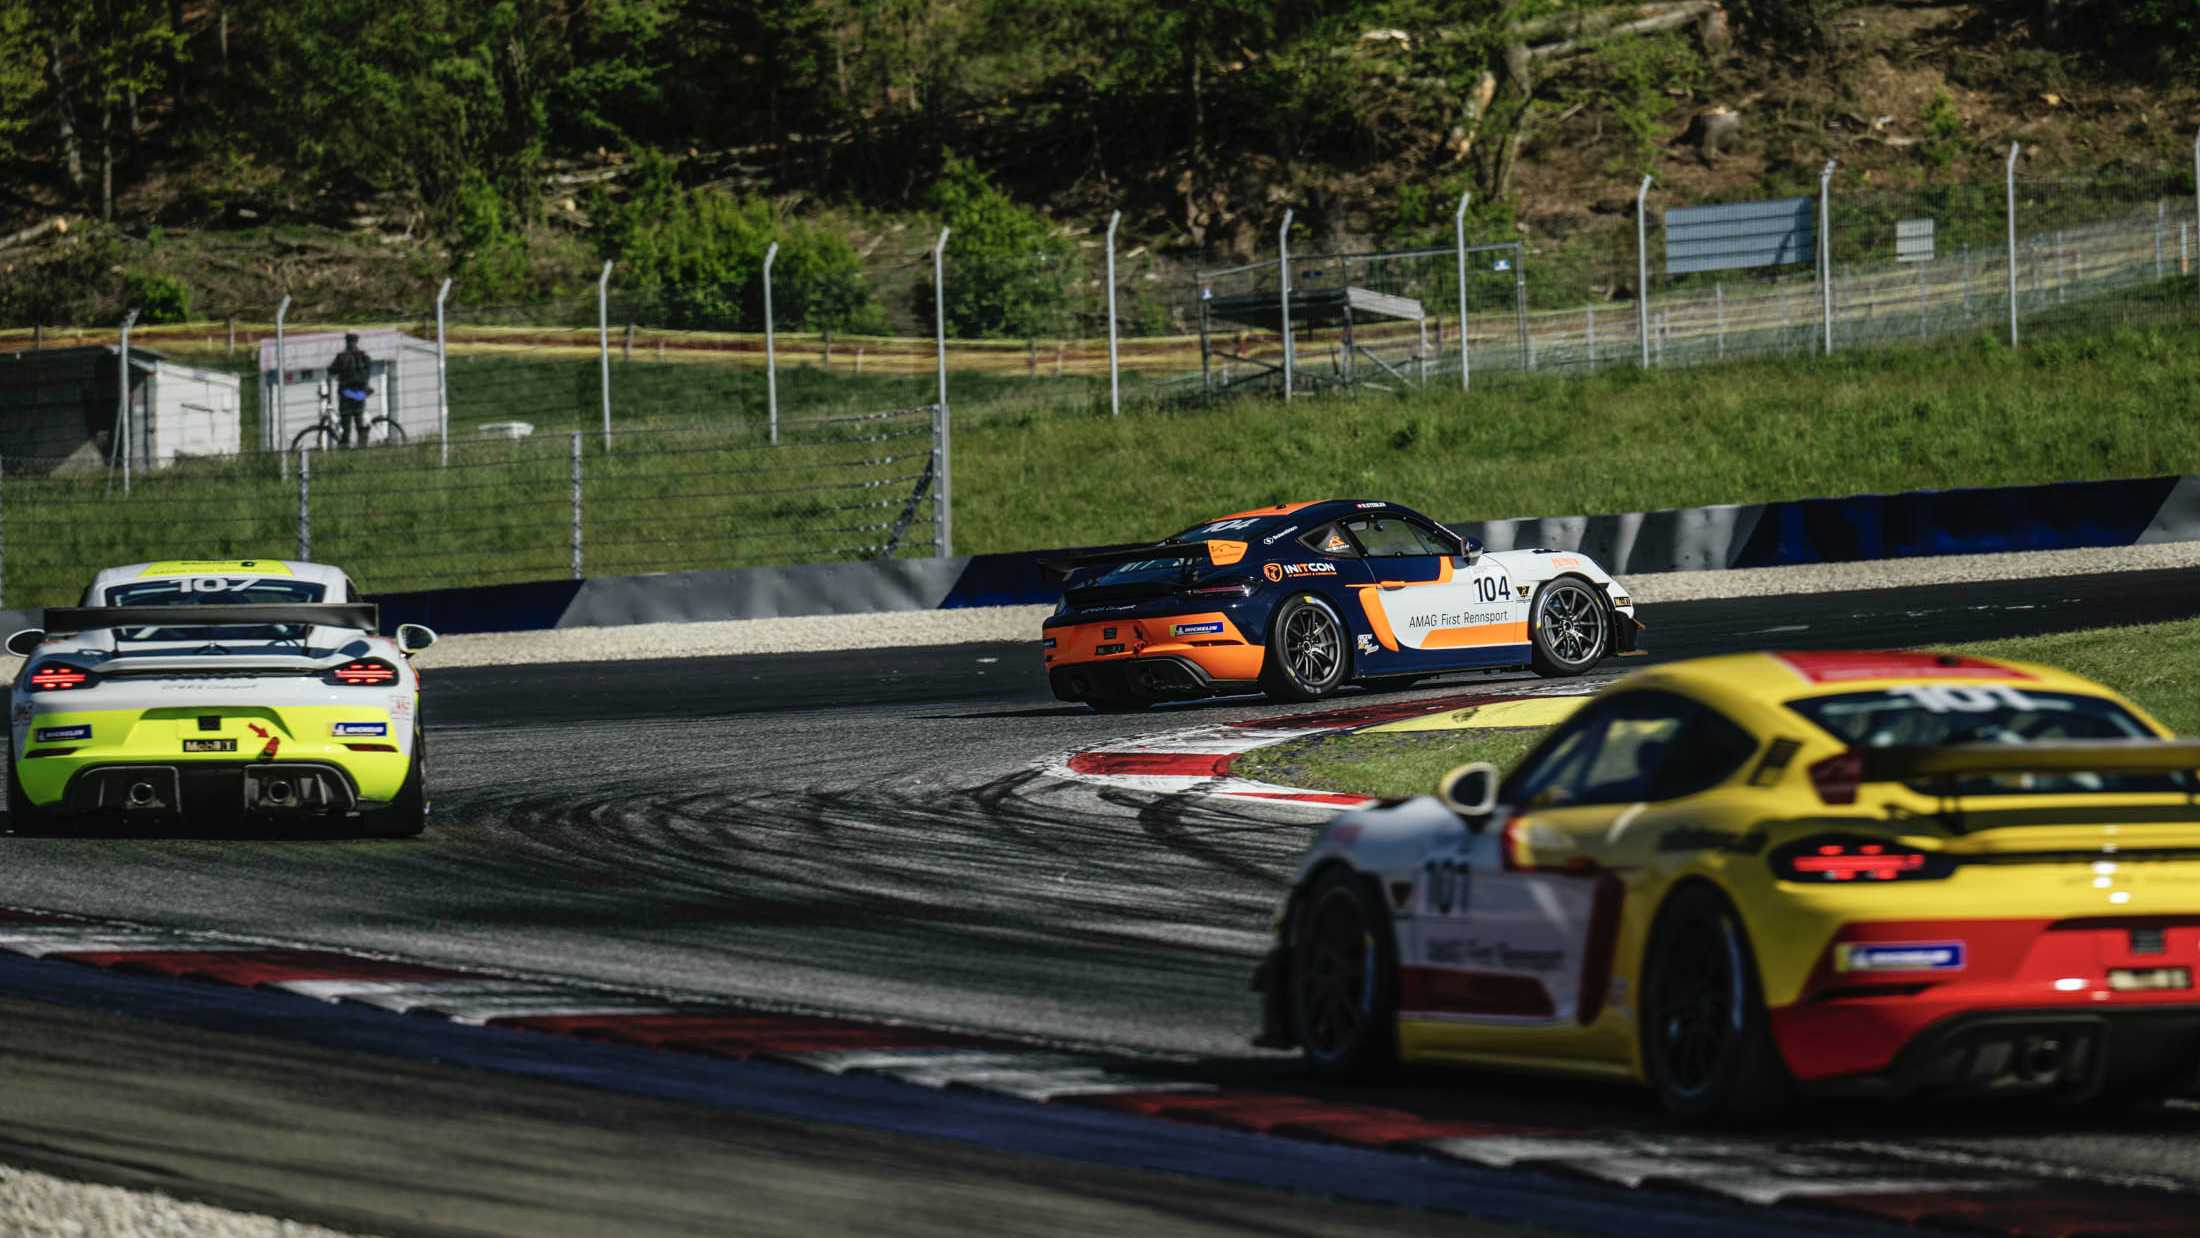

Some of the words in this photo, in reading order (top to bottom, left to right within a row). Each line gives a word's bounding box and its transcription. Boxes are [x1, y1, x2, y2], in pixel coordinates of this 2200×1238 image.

[1283, 563, 1336, 574] INITCON
[168, 578, 260, 593] 107
[1473, 576, 1511, 602] 104
[1409, 614, 1437, 628] AMAG
[1441, 613, 1460, 626] First
[1464, 610, 1508, 625] Rennsport
[1184, 625, 1218, 633] MICHELIN
